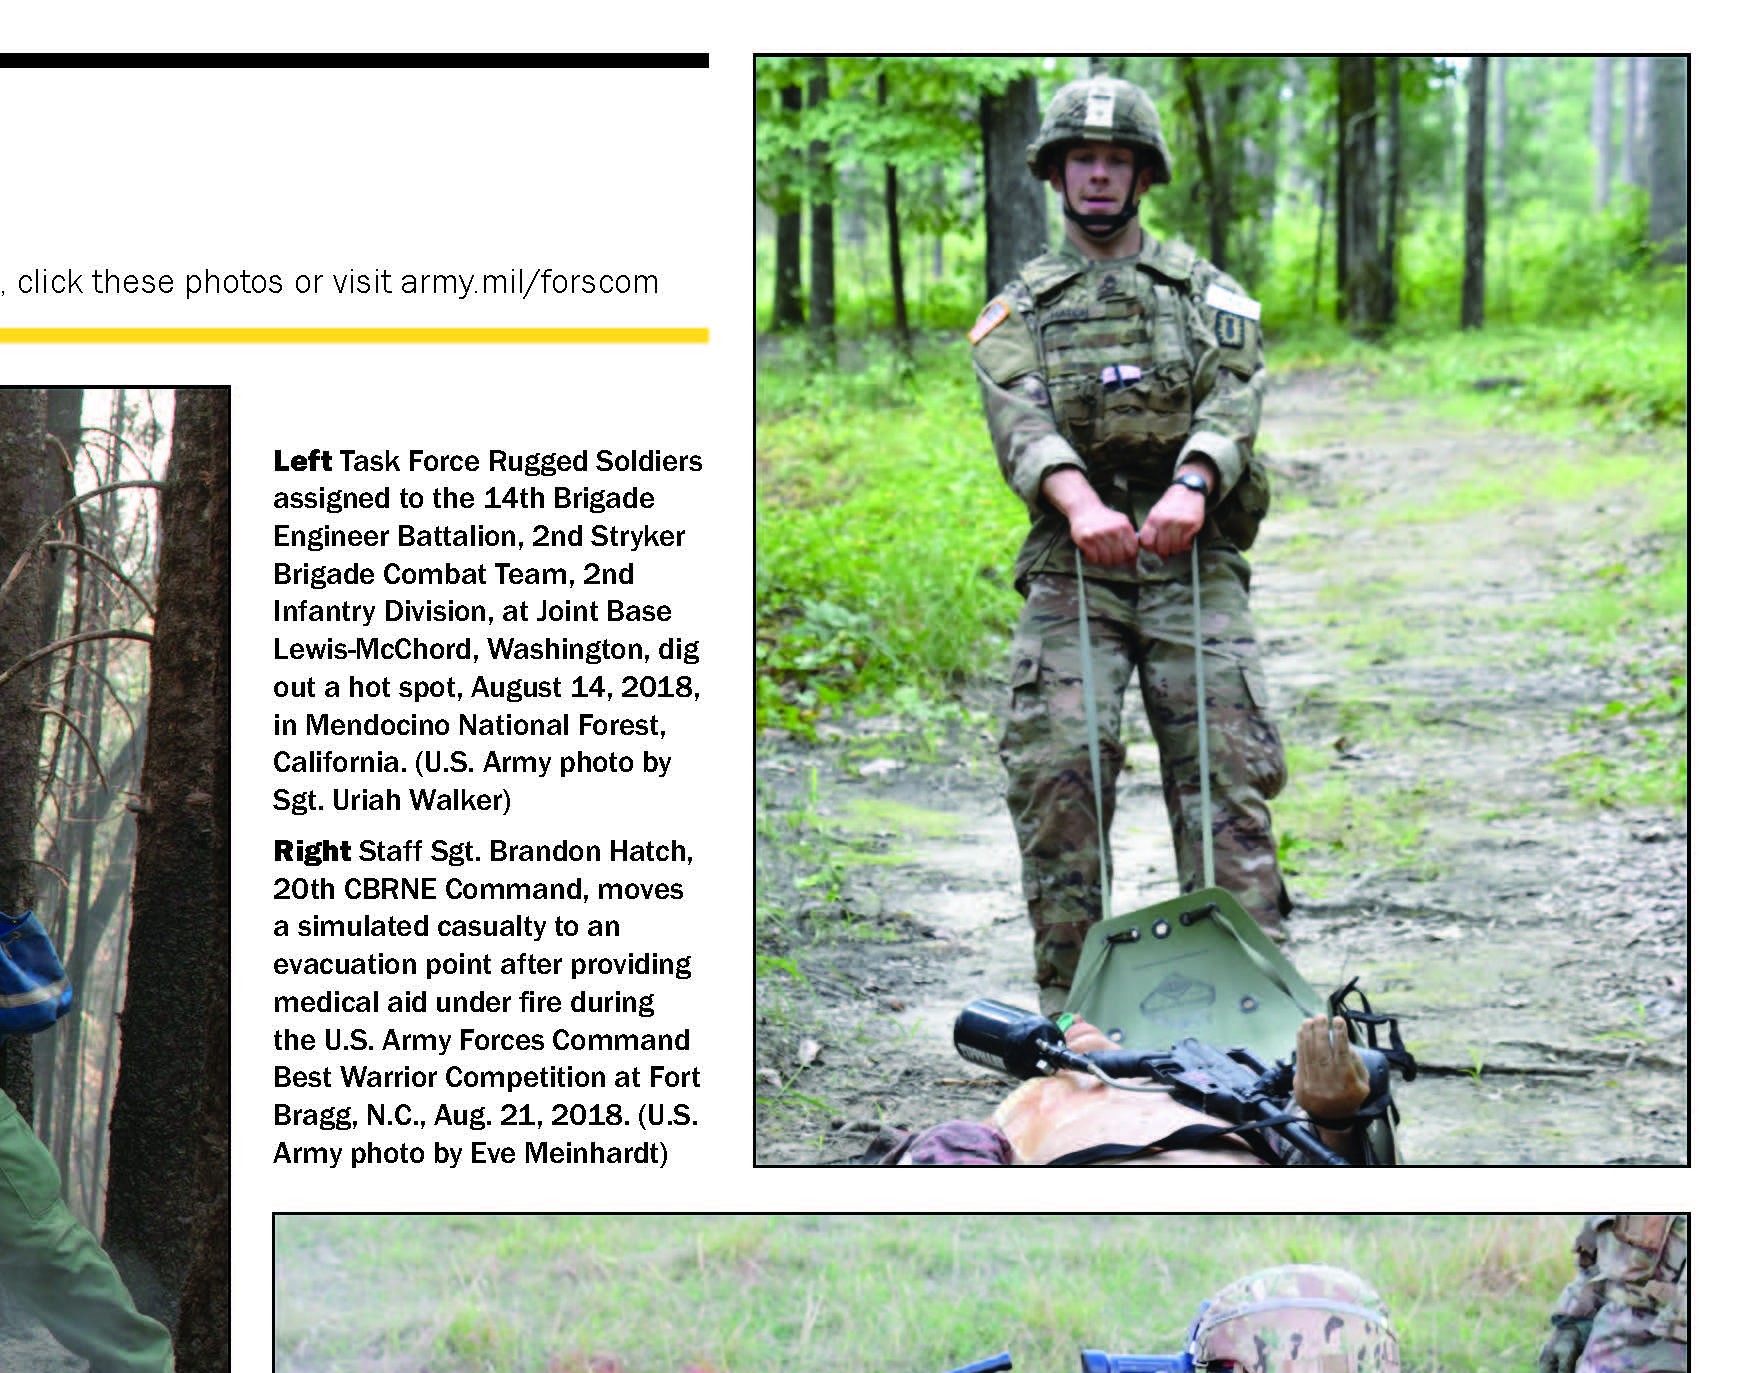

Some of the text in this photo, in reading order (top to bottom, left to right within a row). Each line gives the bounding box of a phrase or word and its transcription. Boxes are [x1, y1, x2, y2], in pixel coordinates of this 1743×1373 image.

[18, 268, 84, 294] click
[91, 268, 174, 294] these
[186, 268, 283, 300] photos
[295, 274, 324, 294] or
[332, 268, 393, 295] visit
[401, 268, 658, 300] army.mil/forscom
[274, 448, 703, 477] Left Task Force Rugged Soldiers
[273, 486, 655, 514] assigned to the 14th Brigade
[272, 788, 511, 816] Sgt. Uriah Walker)
[274, 839, 693, 867] Right Staff Sgt. Brandon Hatch,
[273, 877, 684, 904] 20th CBRNE Command, moves
